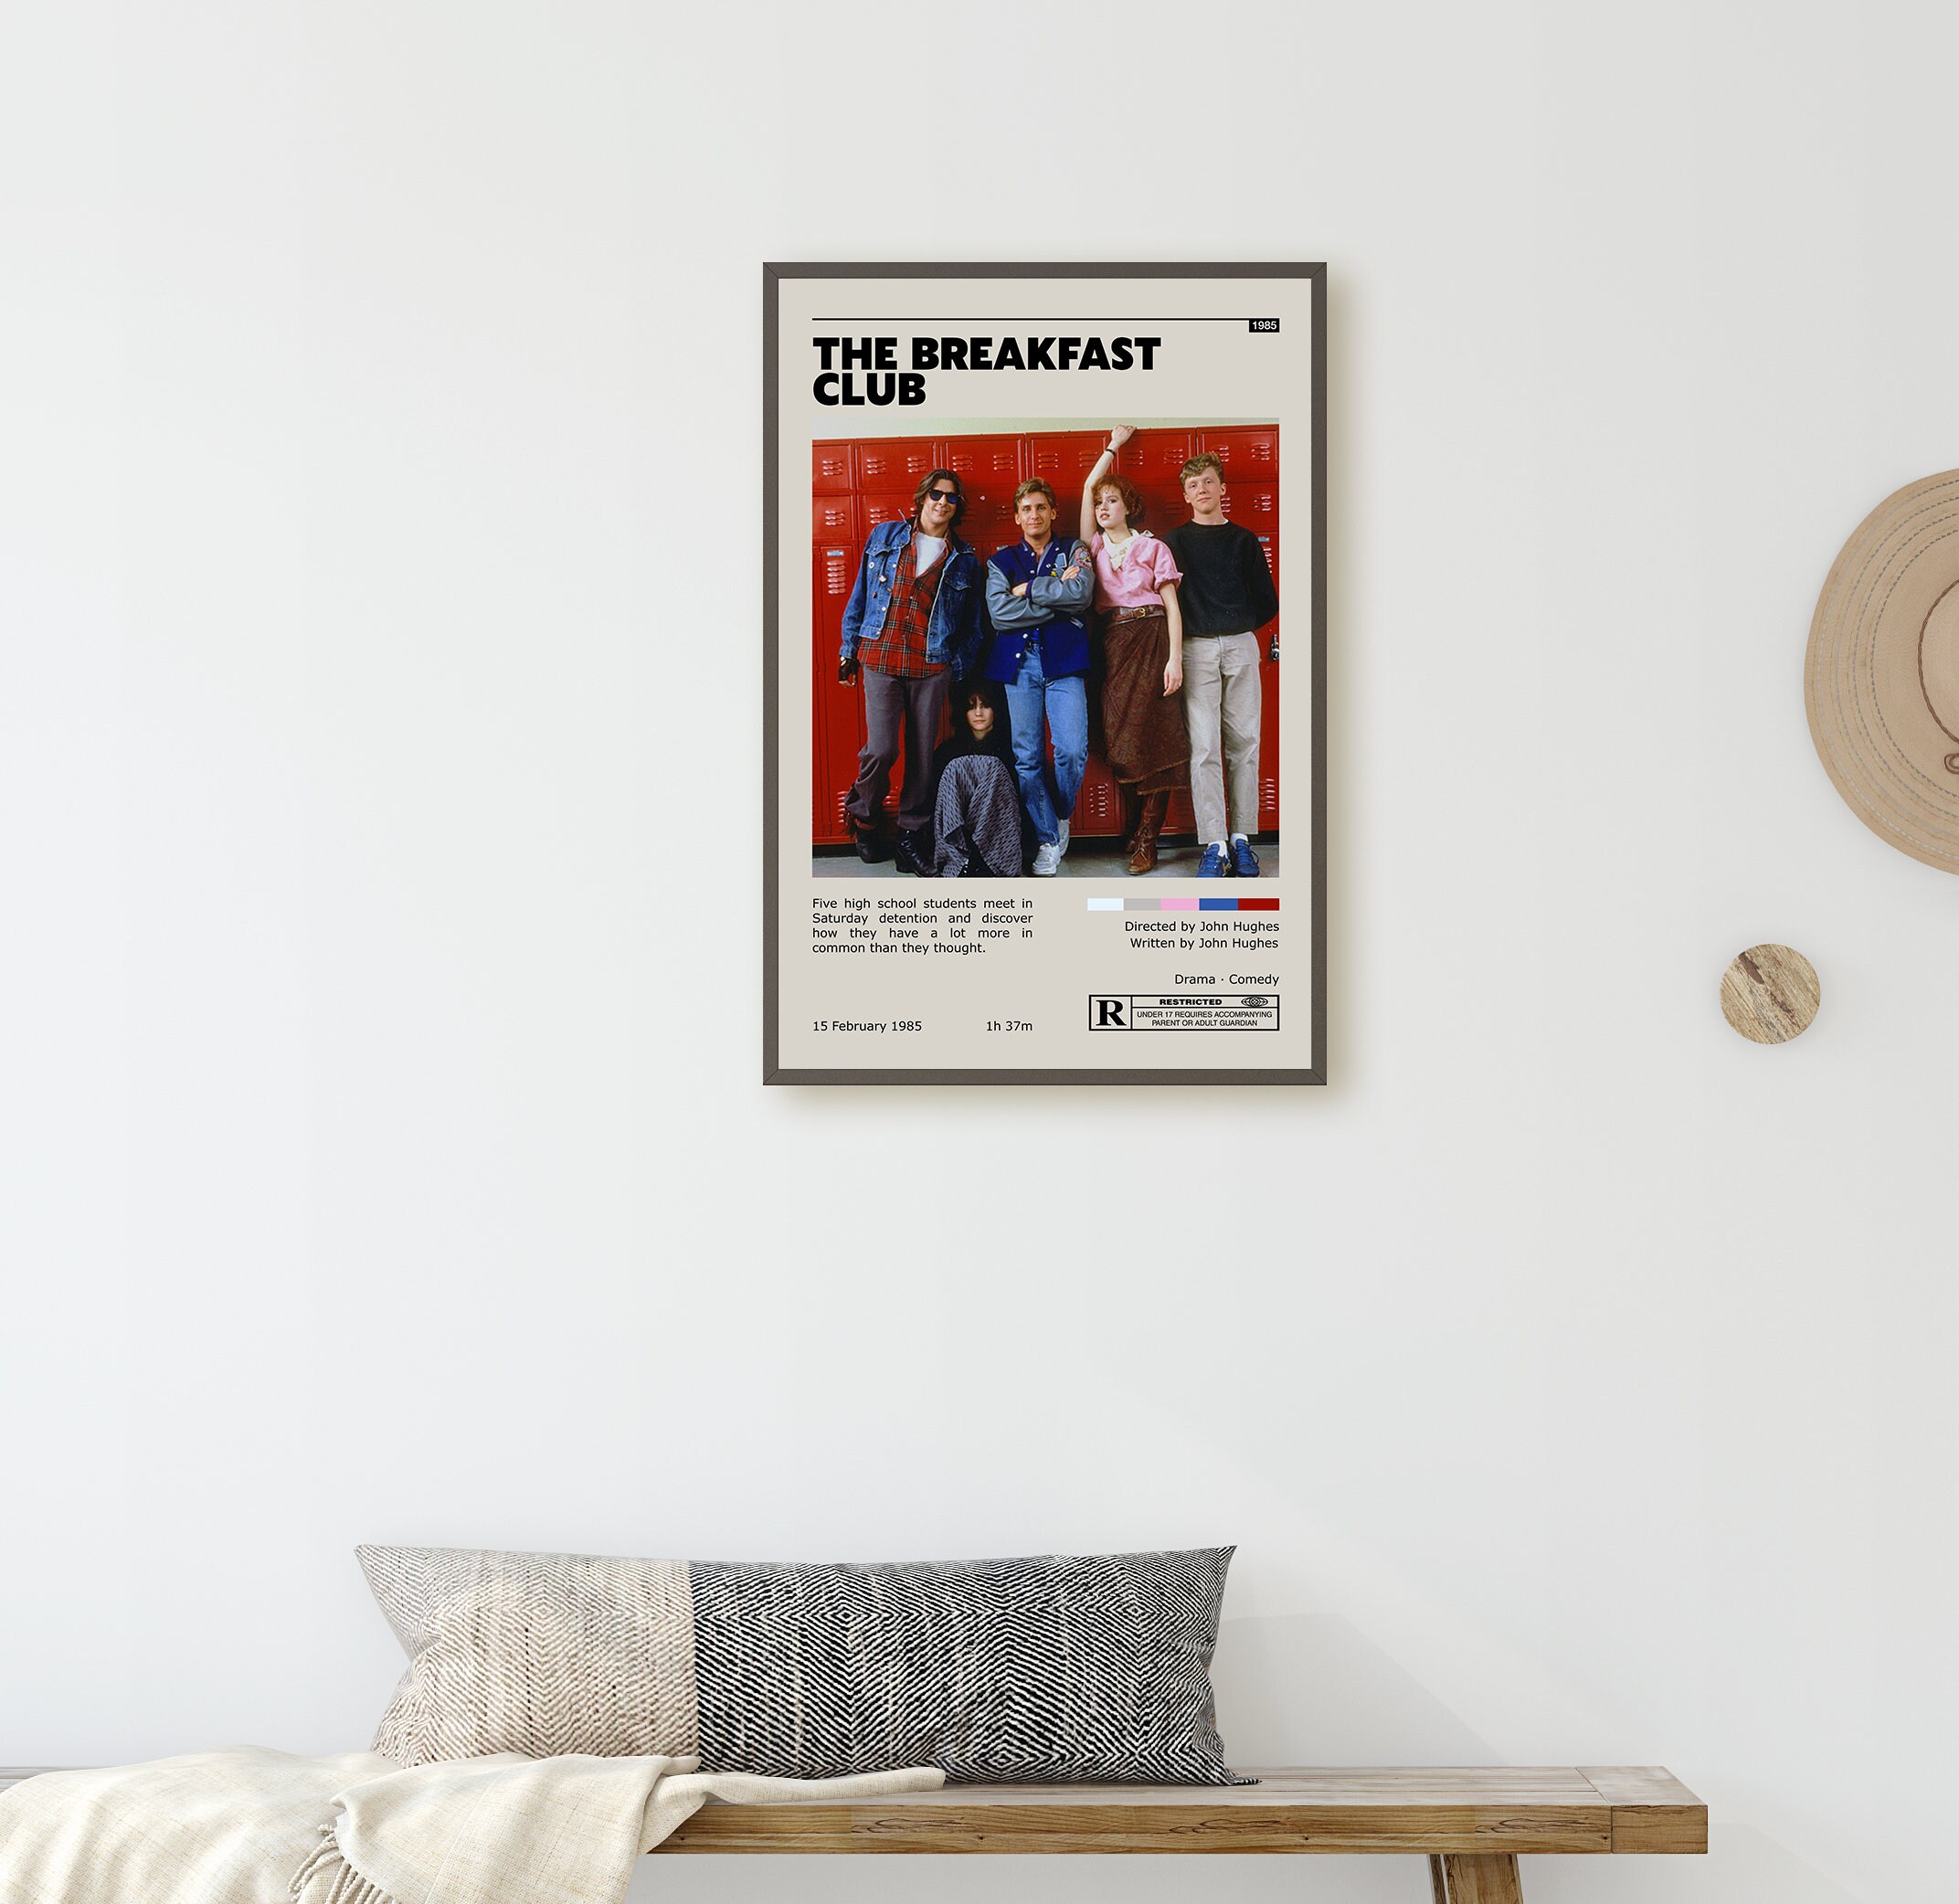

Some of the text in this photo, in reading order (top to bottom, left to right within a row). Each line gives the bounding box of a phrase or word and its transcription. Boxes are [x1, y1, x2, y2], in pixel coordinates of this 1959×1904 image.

[1252, 320, 1277, 330] 1985
[812, 336, 1162, 371] THE BREAKFAST
[812, 372, 927, 407] CLUB
[812, 897, 1033, 912] Five high school students meet in
[812, 912, 1034, 926] Saturday detention and discover
[812, 927, 1033, 941] how they have a lot more in
[1125, 920, 1280, 935] Directed by John Hughes
[811, 942, 986, 956] common than they thought.
[1129, 936, 1279, 951] Written by John Hughes
[1174, 973, 1280, 988] Drama Comedy
[1159, 998, 1223, 1006] RESTRICTED
[1095, 1000, 1128, 1027] R
[1137, 1010, 1163, 1019] UNDER
[1174, 1010, 1213, 1019] REQUIRES
[1213, 1010, 1273, 1019] ACCOMPANYING
[813, 1020, 922, 1034] 15 February 1985
[986, 1020, 1033, 1031] 1h 37m
[1151, 1019, 1258, 1027] PARENT OR ADULT GUARDIAN
